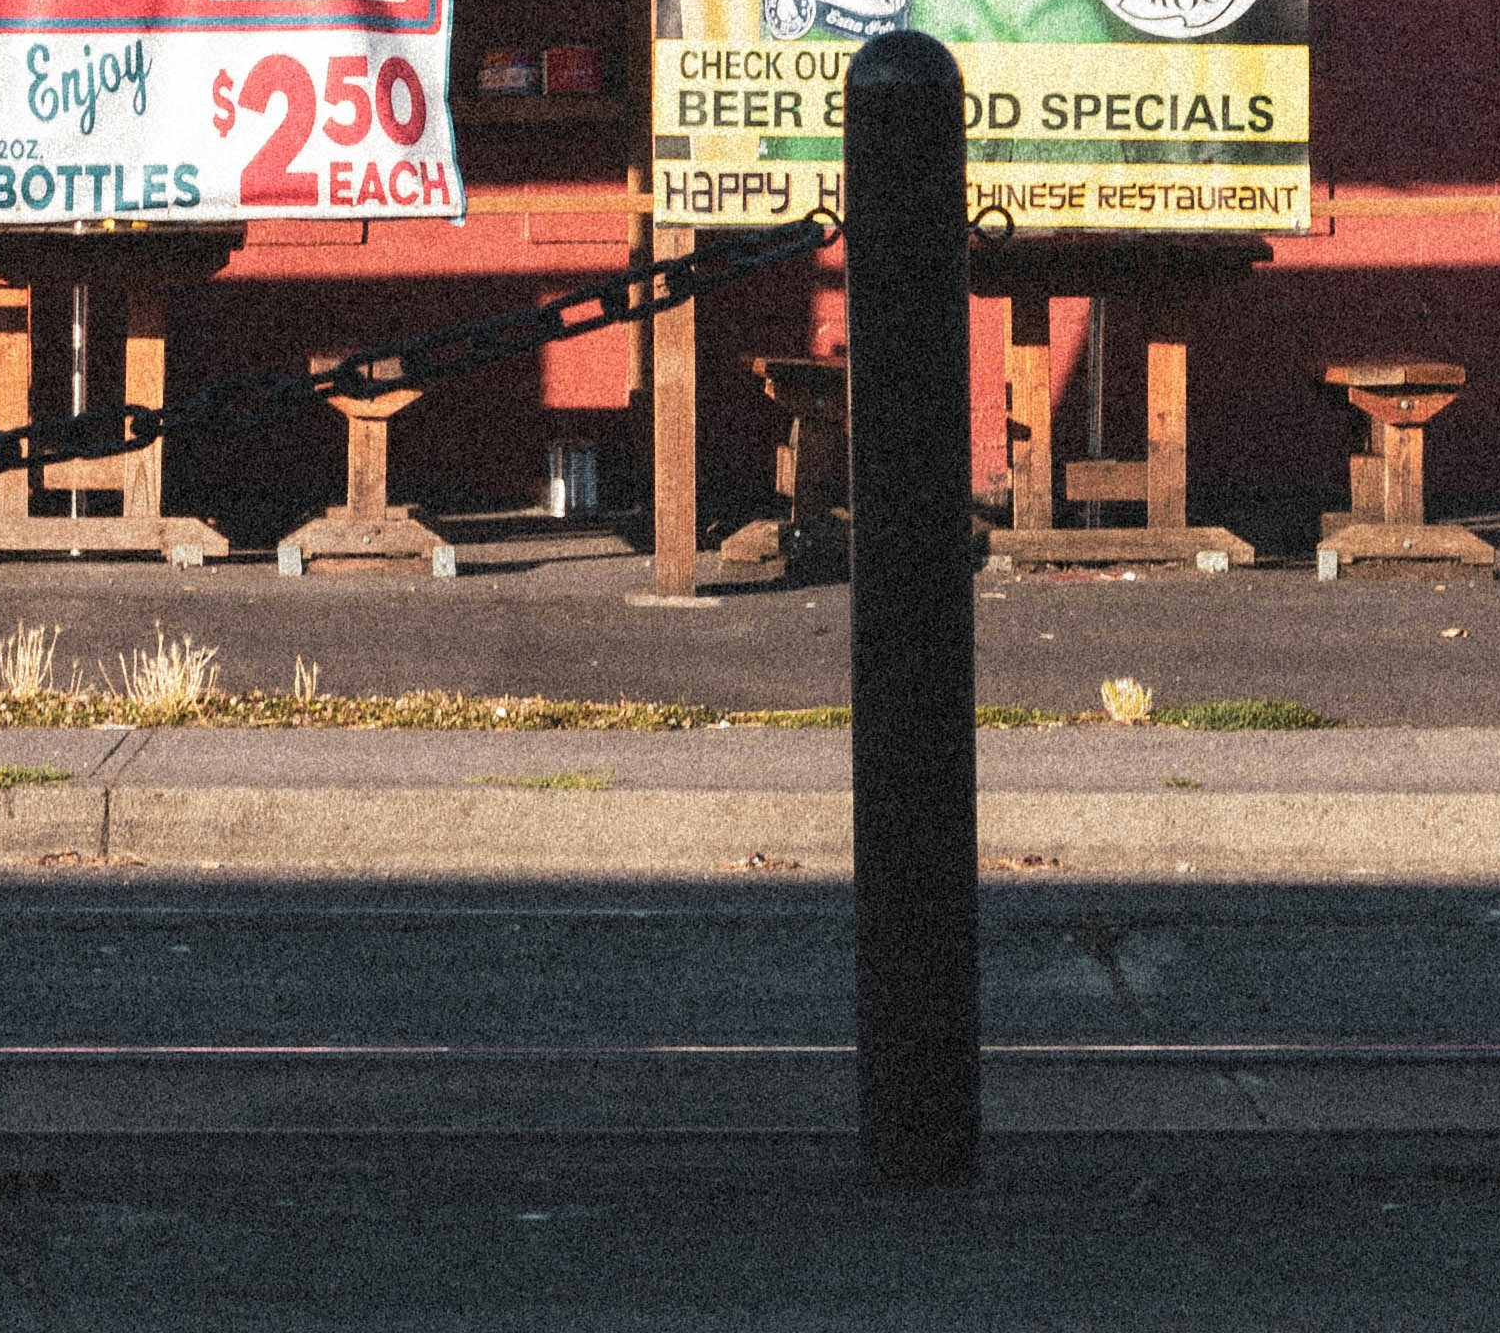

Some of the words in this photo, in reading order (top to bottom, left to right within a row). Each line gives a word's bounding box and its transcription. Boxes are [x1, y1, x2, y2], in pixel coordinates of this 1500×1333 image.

[27, 38, 154, 134] Enjoy
[680, 51, 782, 80] CHECK
[679, 91, 801, 127] BEER
[1041, 93, 1274, 132] SPECIALS
[330, 161, 449, 207] EACH
